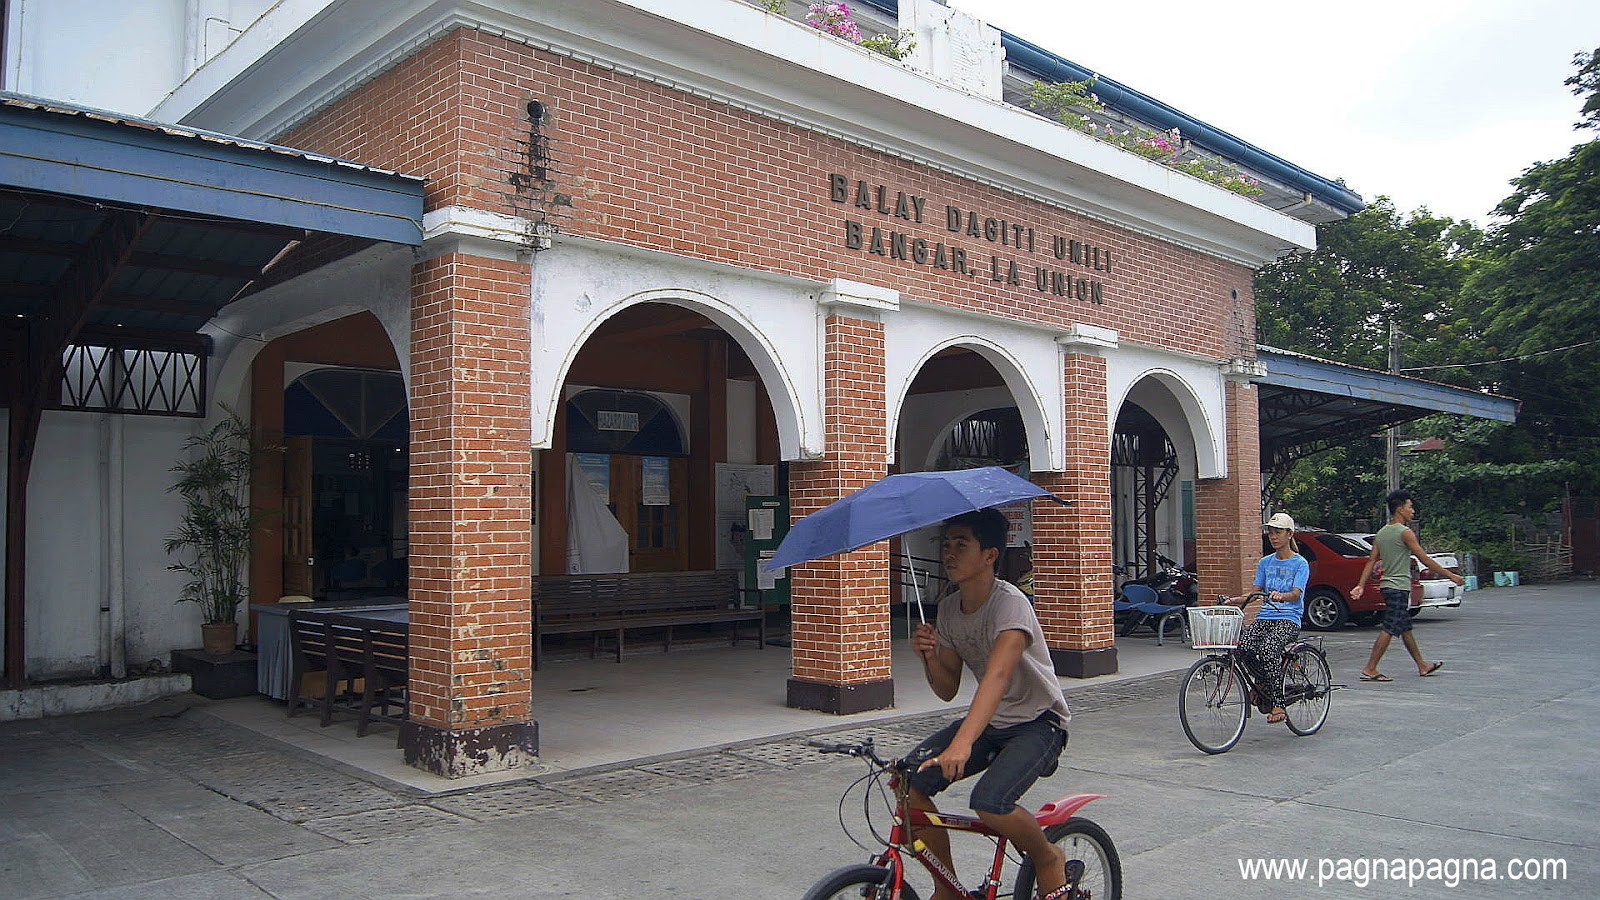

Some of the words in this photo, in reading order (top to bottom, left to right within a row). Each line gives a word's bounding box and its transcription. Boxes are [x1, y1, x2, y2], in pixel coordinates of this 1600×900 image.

[830, 173, 925, 223] BALAY
[946, 205, 1034, 252] DAGITI
[1054, 237, 1112, 273] UMILI
[845, 220, 976, 278] BANGAR,
[992, 256, 1020, 286] LA
[1036, 266, 1103, 304] UNION
